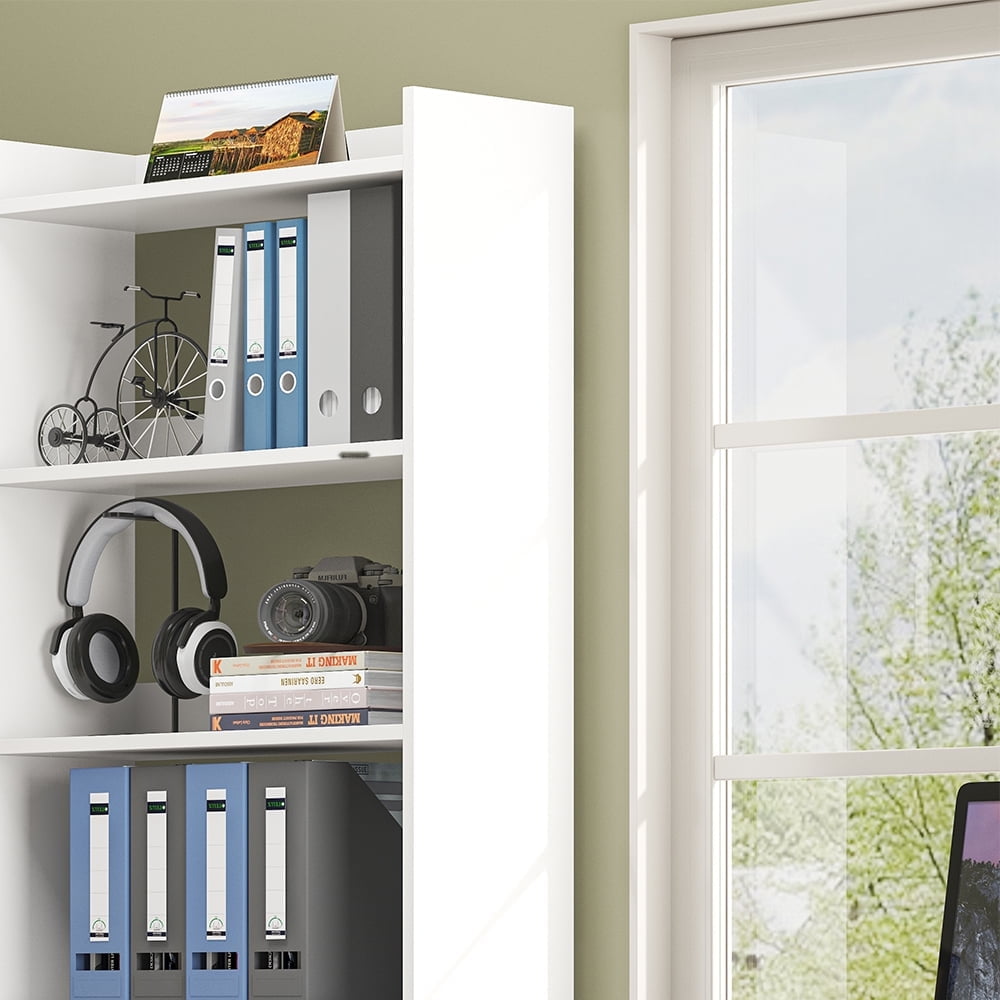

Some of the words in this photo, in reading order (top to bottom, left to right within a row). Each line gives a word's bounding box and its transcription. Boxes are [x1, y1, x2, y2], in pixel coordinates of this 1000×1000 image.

[306, 658, 316, 668] IT
[318, 656, 356, 668] MAKING
[280, 678, 308, 686] SAARINEN
[312, 676, 325, 685] EERO
[308, 714, 318, 726] IT
[320, 713, 360, 726] MAKING
